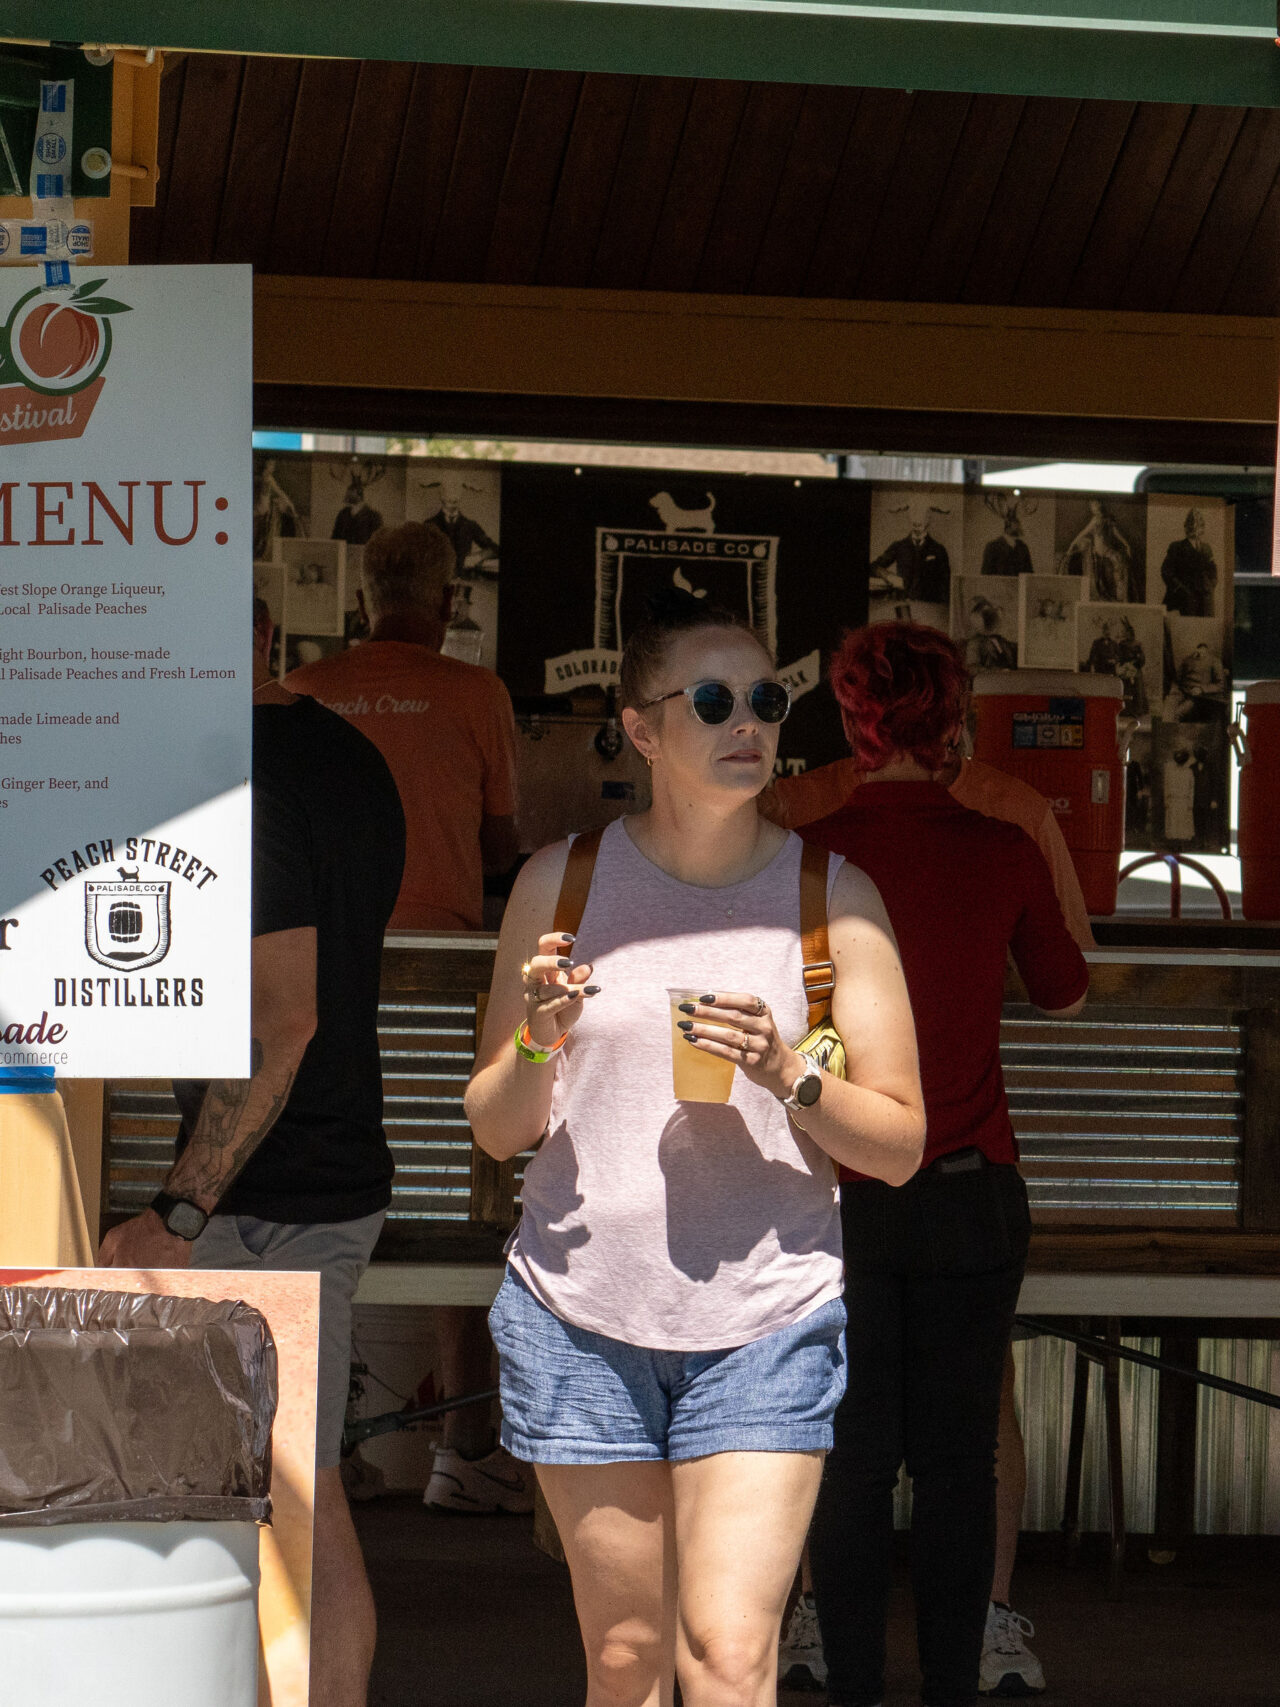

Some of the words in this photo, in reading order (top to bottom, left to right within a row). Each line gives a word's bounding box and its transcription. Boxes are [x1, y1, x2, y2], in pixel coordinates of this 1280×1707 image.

[624, 538, 717, 554] PALISADE
[724, 544, 749, 555] CO
[0, 583, 19, 597] est
[22, 583, 57, 598] Slope
[60, 583, 108, 598] Orange
[111, 582, 166, 598] Liqueur,
[38, 602, 91, 615] Palisade
[95, 602, 148, 615] Peaches
[27, 648, 87, 663] Bourbon,
[91, 647, 171, 660] house-made
[9, 667, 63, 680] Palisade
[66, 667, 118, 680] Peaches
[121, 667, 146, 680] and
[150, 667, 186, 680] Fresh
[190, 667, 237, 680] Lemon
[375, 694, 430, 714] Crew
[36, 712, 92, 725] Limeade
[95, 712, 120, 725] and
[1, 778, 45, 792] Ginger
[49, 778, 81, 791] Beer,
[84, 777, 109, 789] and
[39, 838, 116, 891] PEACH
[126, 837, 218, 890] STREET
[54, 978, 204, 1007] DISTILLERS
[0, 1011, 68, 1045] ade
